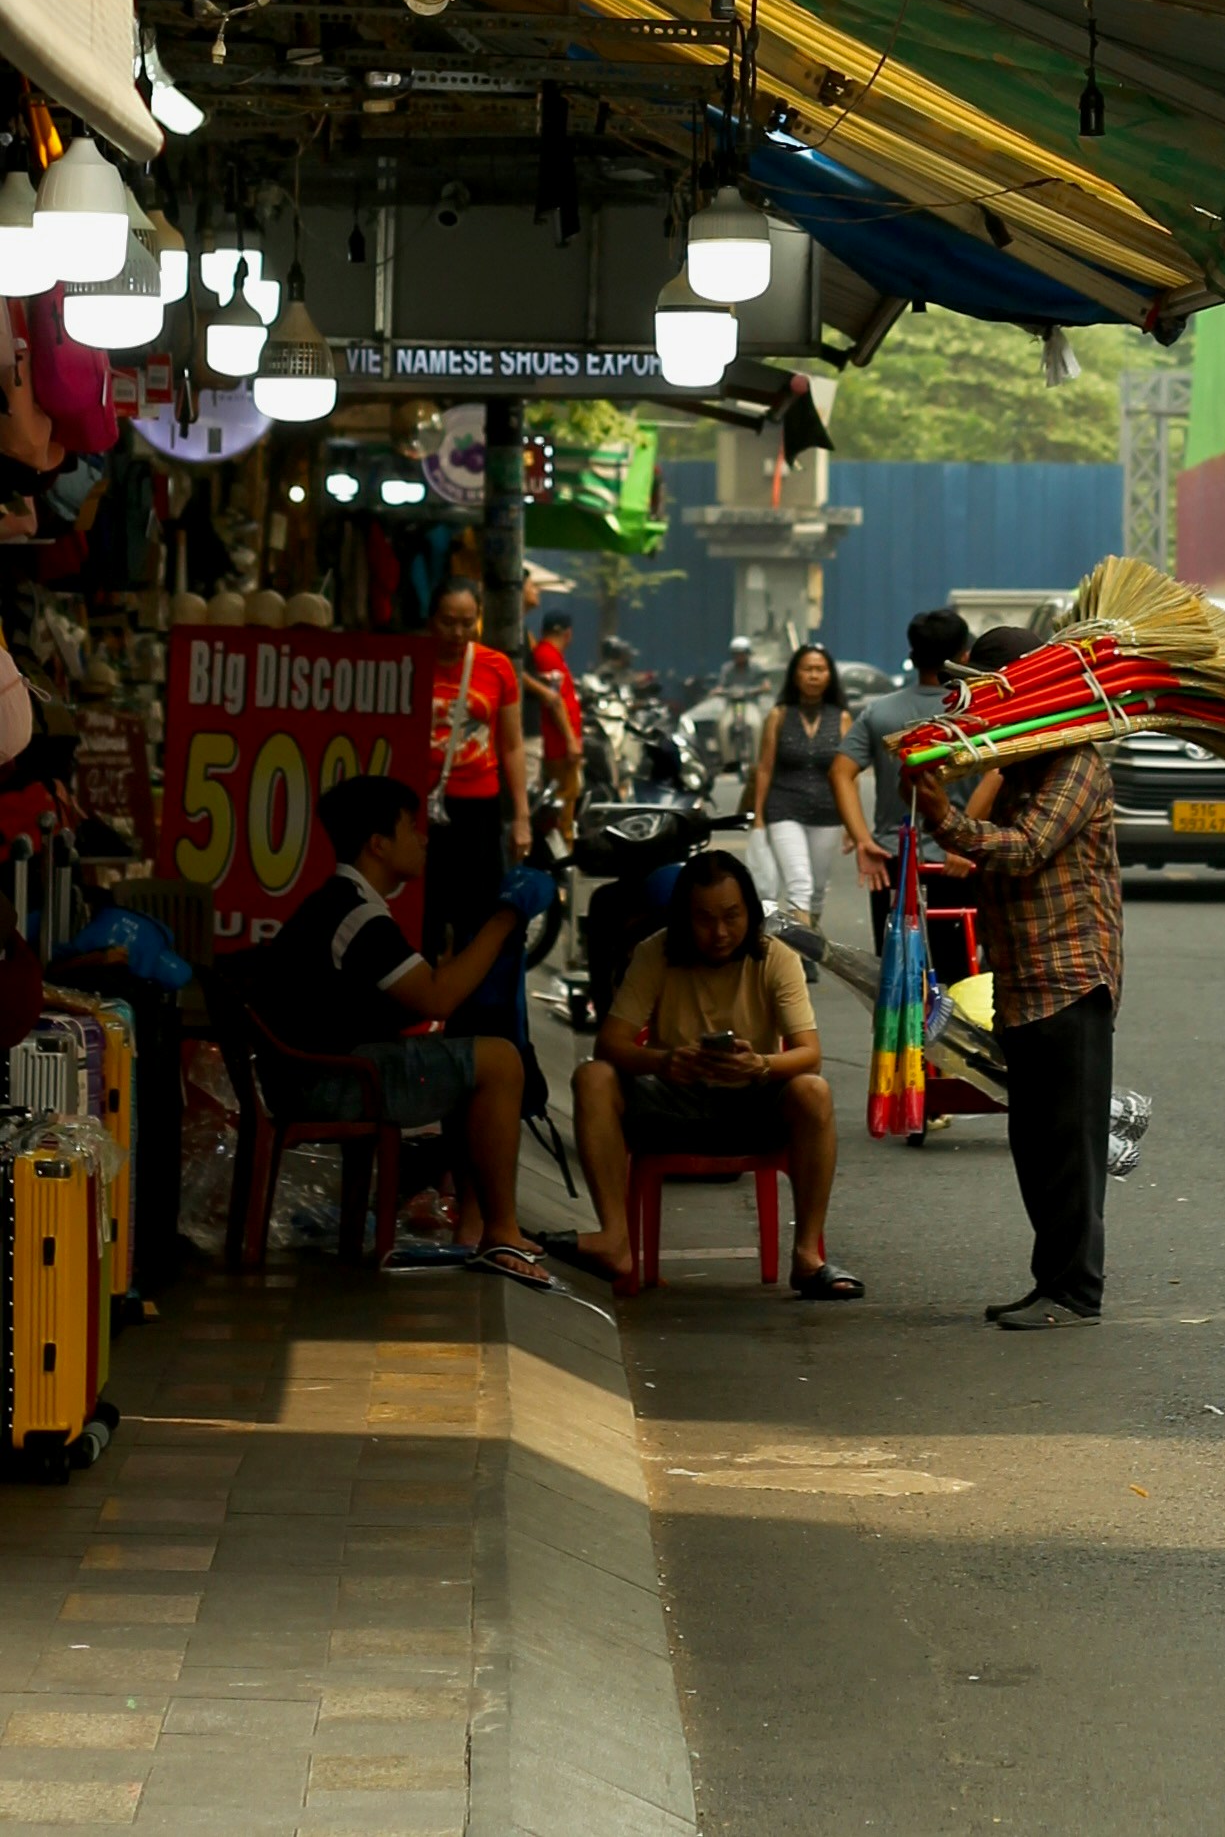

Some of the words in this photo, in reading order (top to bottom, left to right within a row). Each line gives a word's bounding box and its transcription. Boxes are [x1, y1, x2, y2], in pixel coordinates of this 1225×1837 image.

[346, 349, 493, 376] VIENAMESE
[188, 639, 246, 716] Big
[254, 642, 413, 715] Discount
